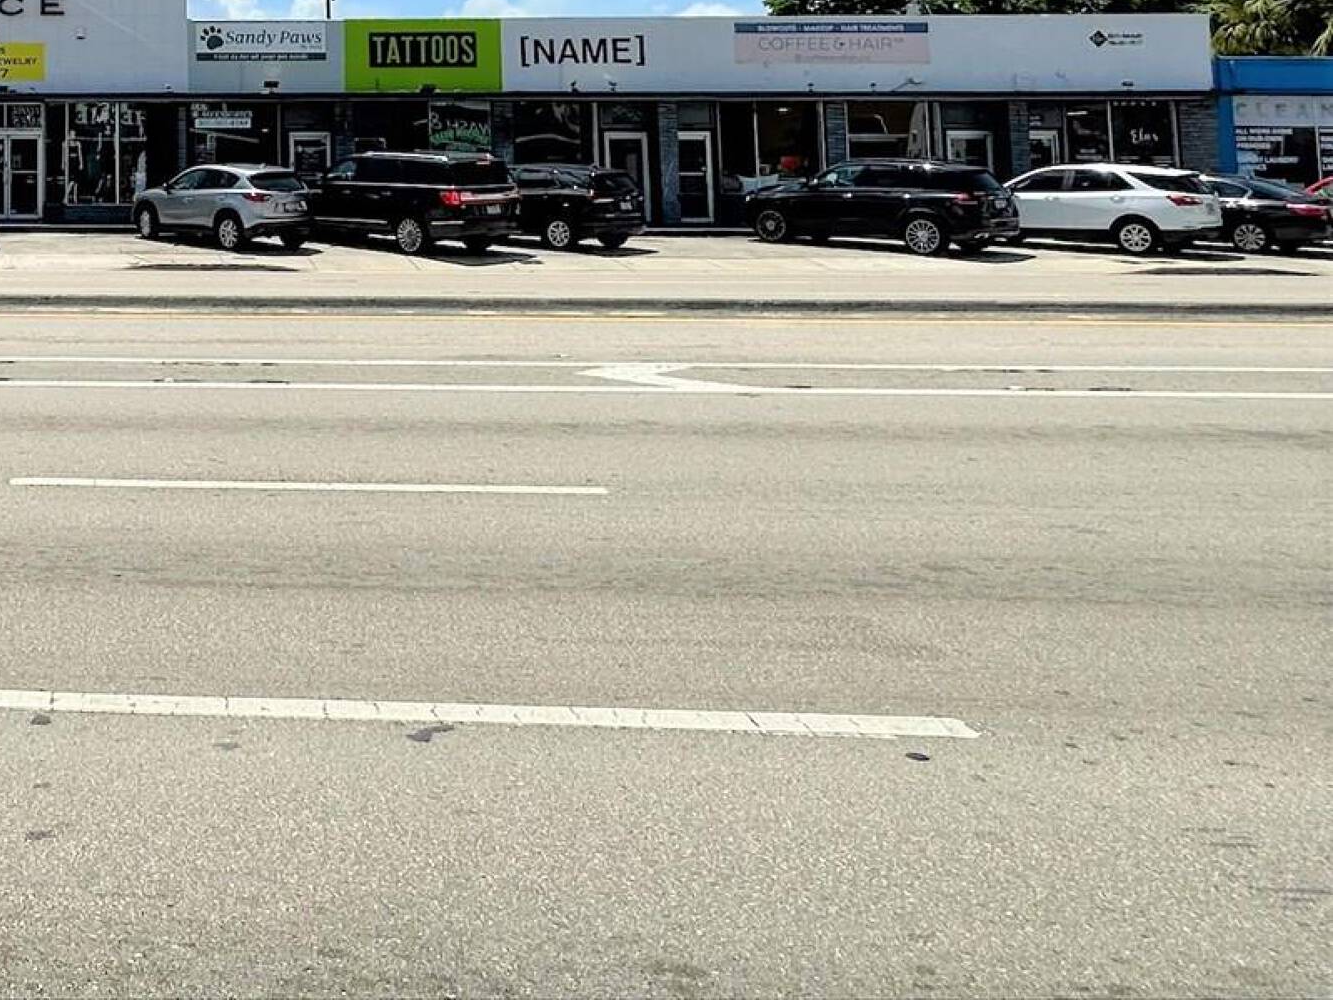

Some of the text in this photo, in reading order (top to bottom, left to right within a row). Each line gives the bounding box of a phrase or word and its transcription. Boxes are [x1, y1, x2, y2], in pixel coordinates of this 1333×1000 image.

[226, 30, 322, 48] Sandy Paws
[372, 35, 475, 65] TATTOOS
[520, 35, 646, 67] [NAME]
[758, 36, 831, 51] COFFEE
[847, 36, 893, 51] HAIR
